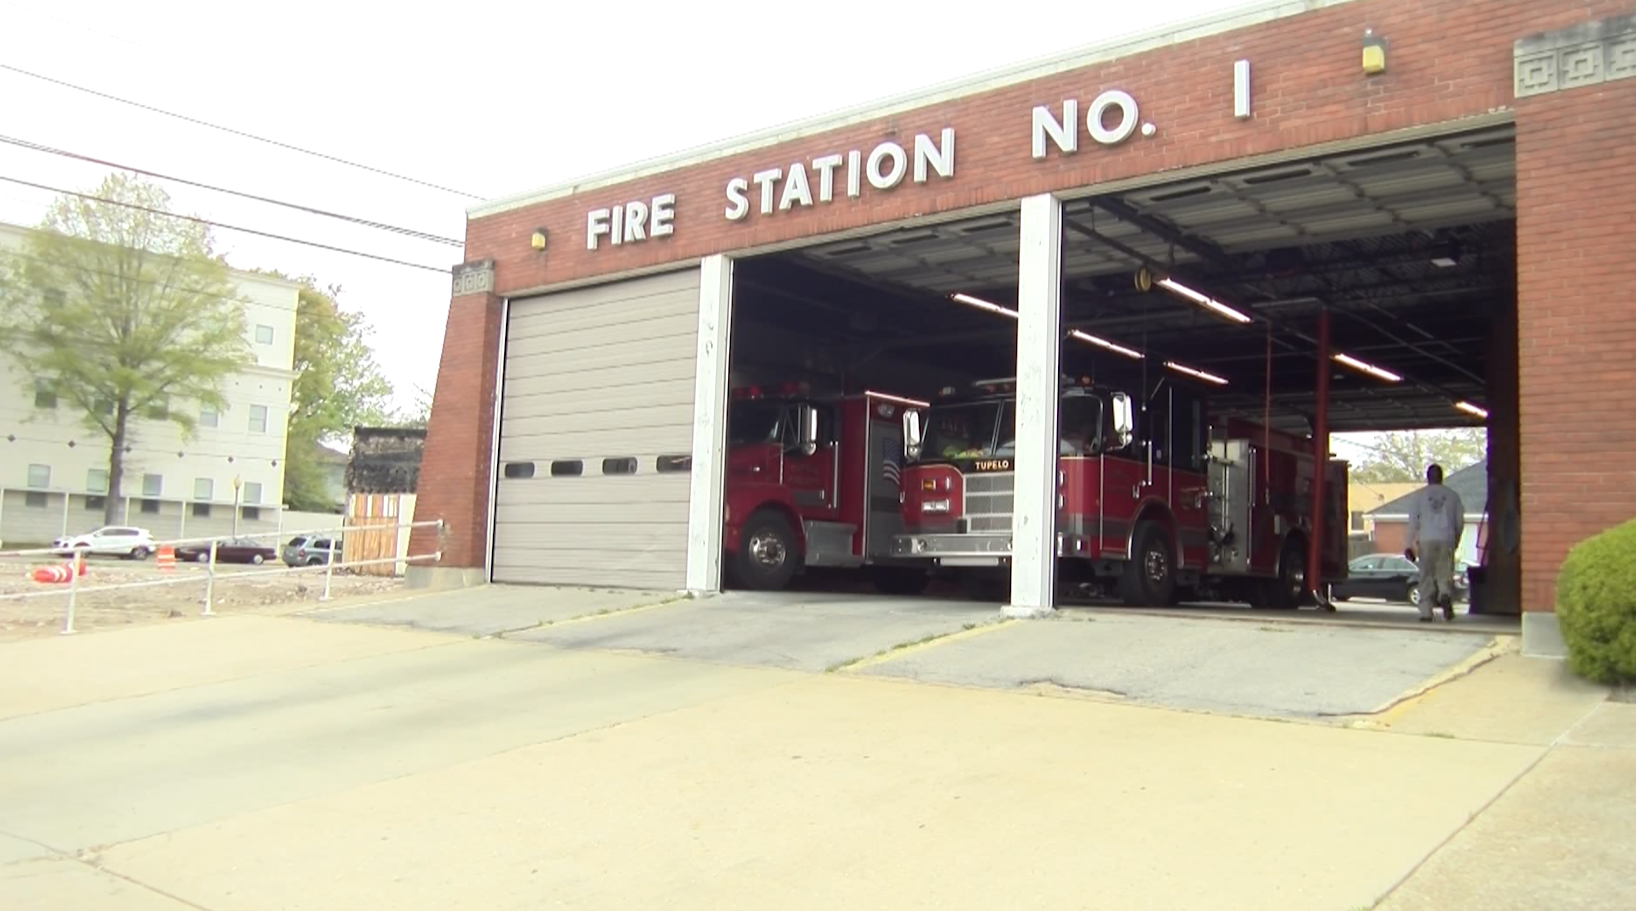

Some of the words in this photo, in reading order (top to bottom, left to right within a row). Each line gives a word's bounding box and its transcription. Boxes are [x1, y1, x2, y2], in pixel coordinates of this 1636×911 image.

[586, 193, 677, 250] FIRE
[724, 127, 956, 220] STATION
[1031, 89, 1157, 159] NO.
[975, 460, 1009, 470] TUPELO
